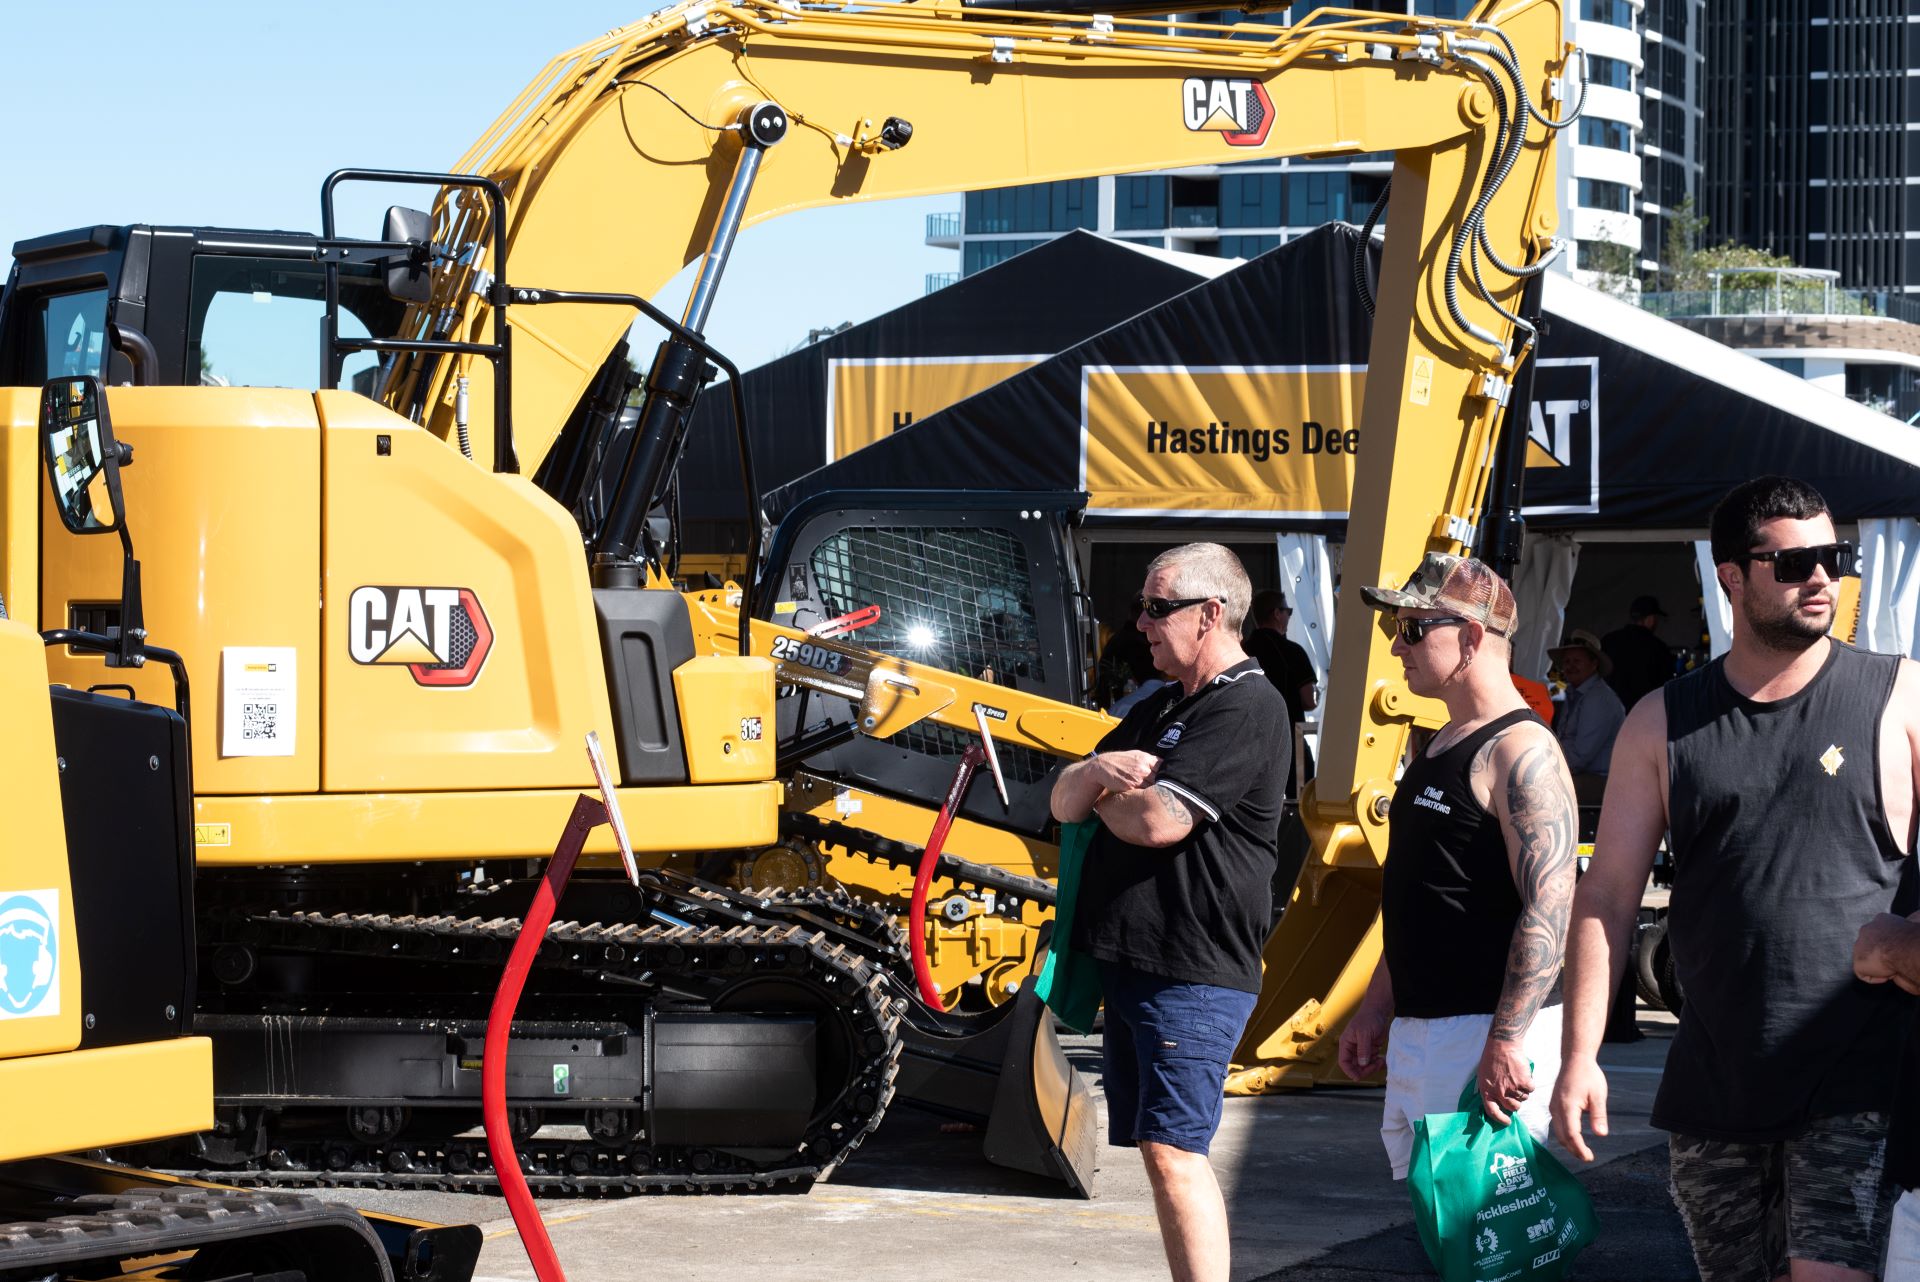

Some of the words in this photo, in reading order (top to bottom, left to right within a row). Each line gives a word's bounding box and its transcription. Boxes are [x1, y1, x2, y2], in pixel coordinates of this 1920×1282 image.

[1184, 77, 1252, 130] CAT
[1147, 421, 1290, 462] Hastings
[1527, 399, 1579, 467] AT
[350, 587, 459, 663] CAT
[770, 635, 842, 674] 259D3
[741, 717, 757, 741] 315
[1502, 1165, 1527, 1179] FIELD
[1505, 1173, 1528, 1186] DAYS
